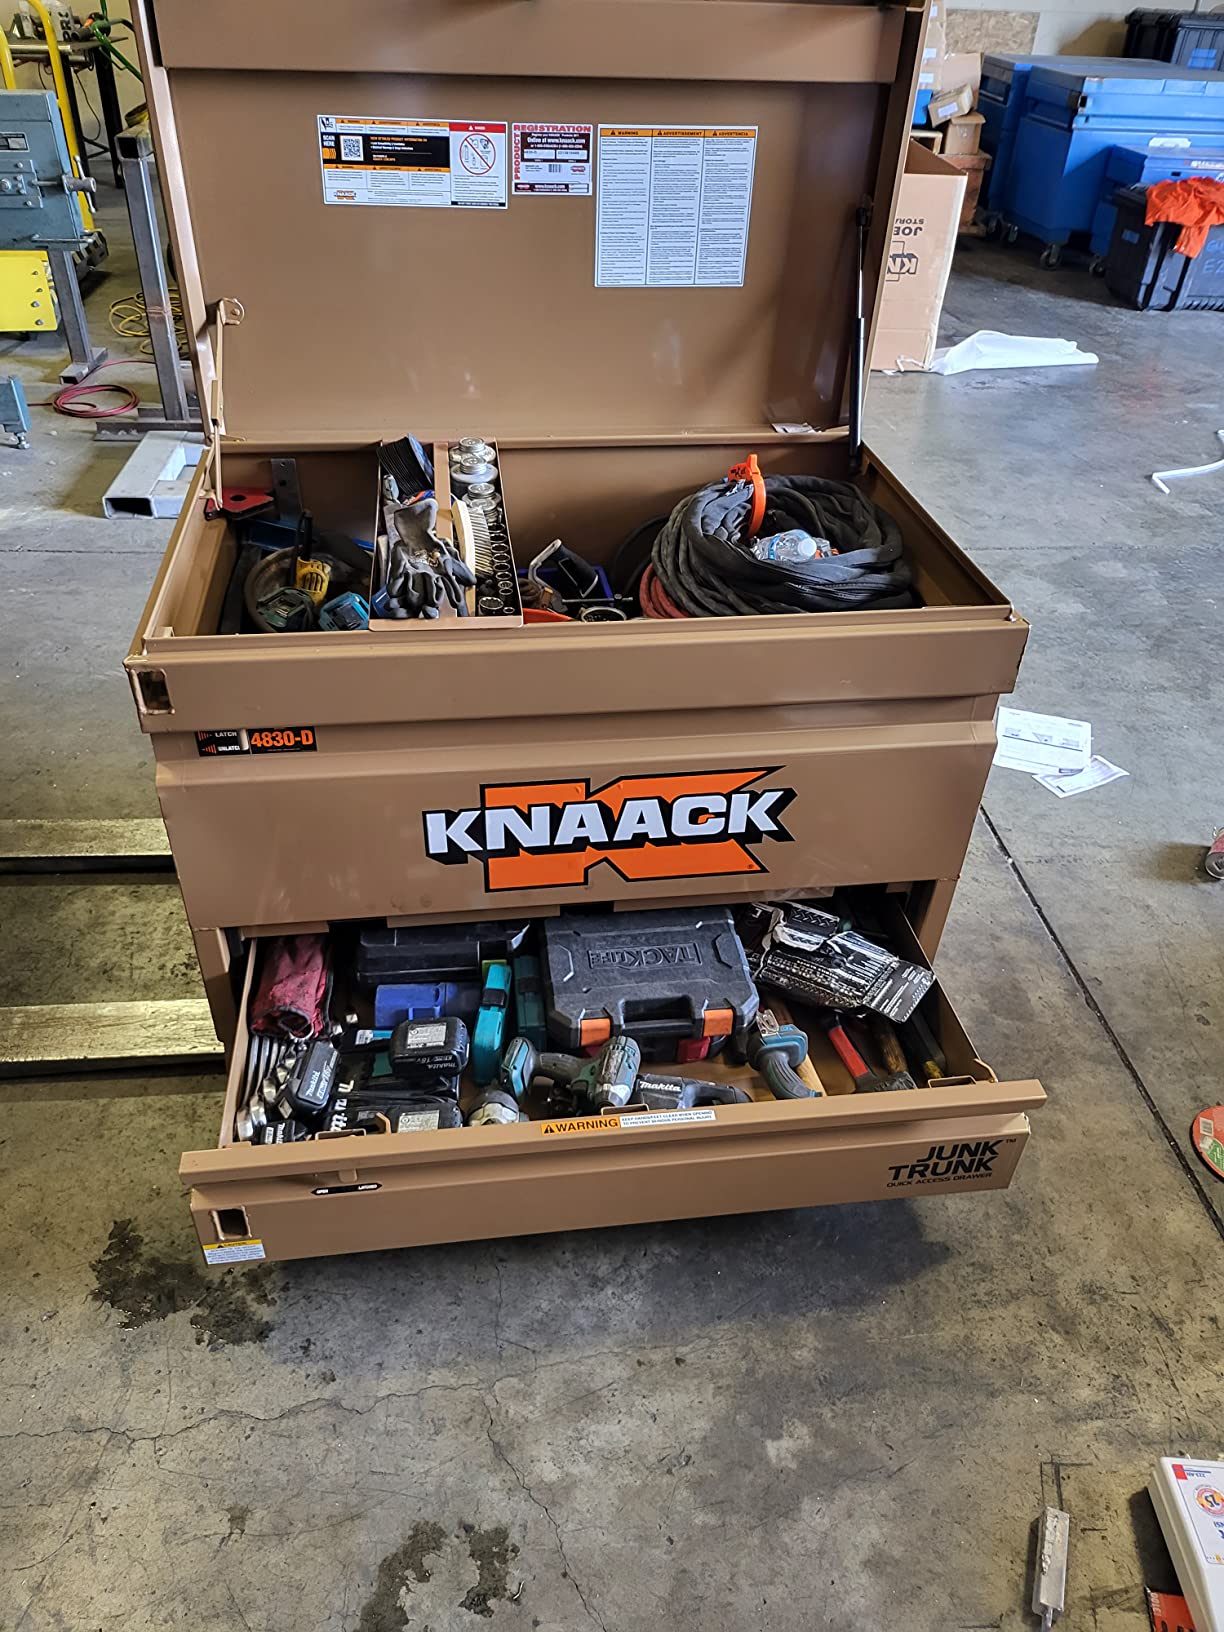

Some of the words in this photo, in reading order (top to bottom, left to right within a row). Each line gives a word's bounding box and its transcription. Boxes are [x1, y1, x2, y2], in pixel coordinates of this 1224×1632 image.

[513, 124, 591, 132] REGISTRATION
[250, 729, 314, 747] 4830-D
[422, 787, 797, 864] KNAACK
[590, 945, 699, 967] TACKLIFE
[555, 1118, 618, 1133] WARNING
[916, 1139, 1003, 1163] JUNK
[888, 1155, 998, 1181] TRUNK
[886, 1180, 913, 1188] QUICK
[915, 1176, 950, 1184] ACCESS
[953, 1172, 992, 1181] DRAWER
